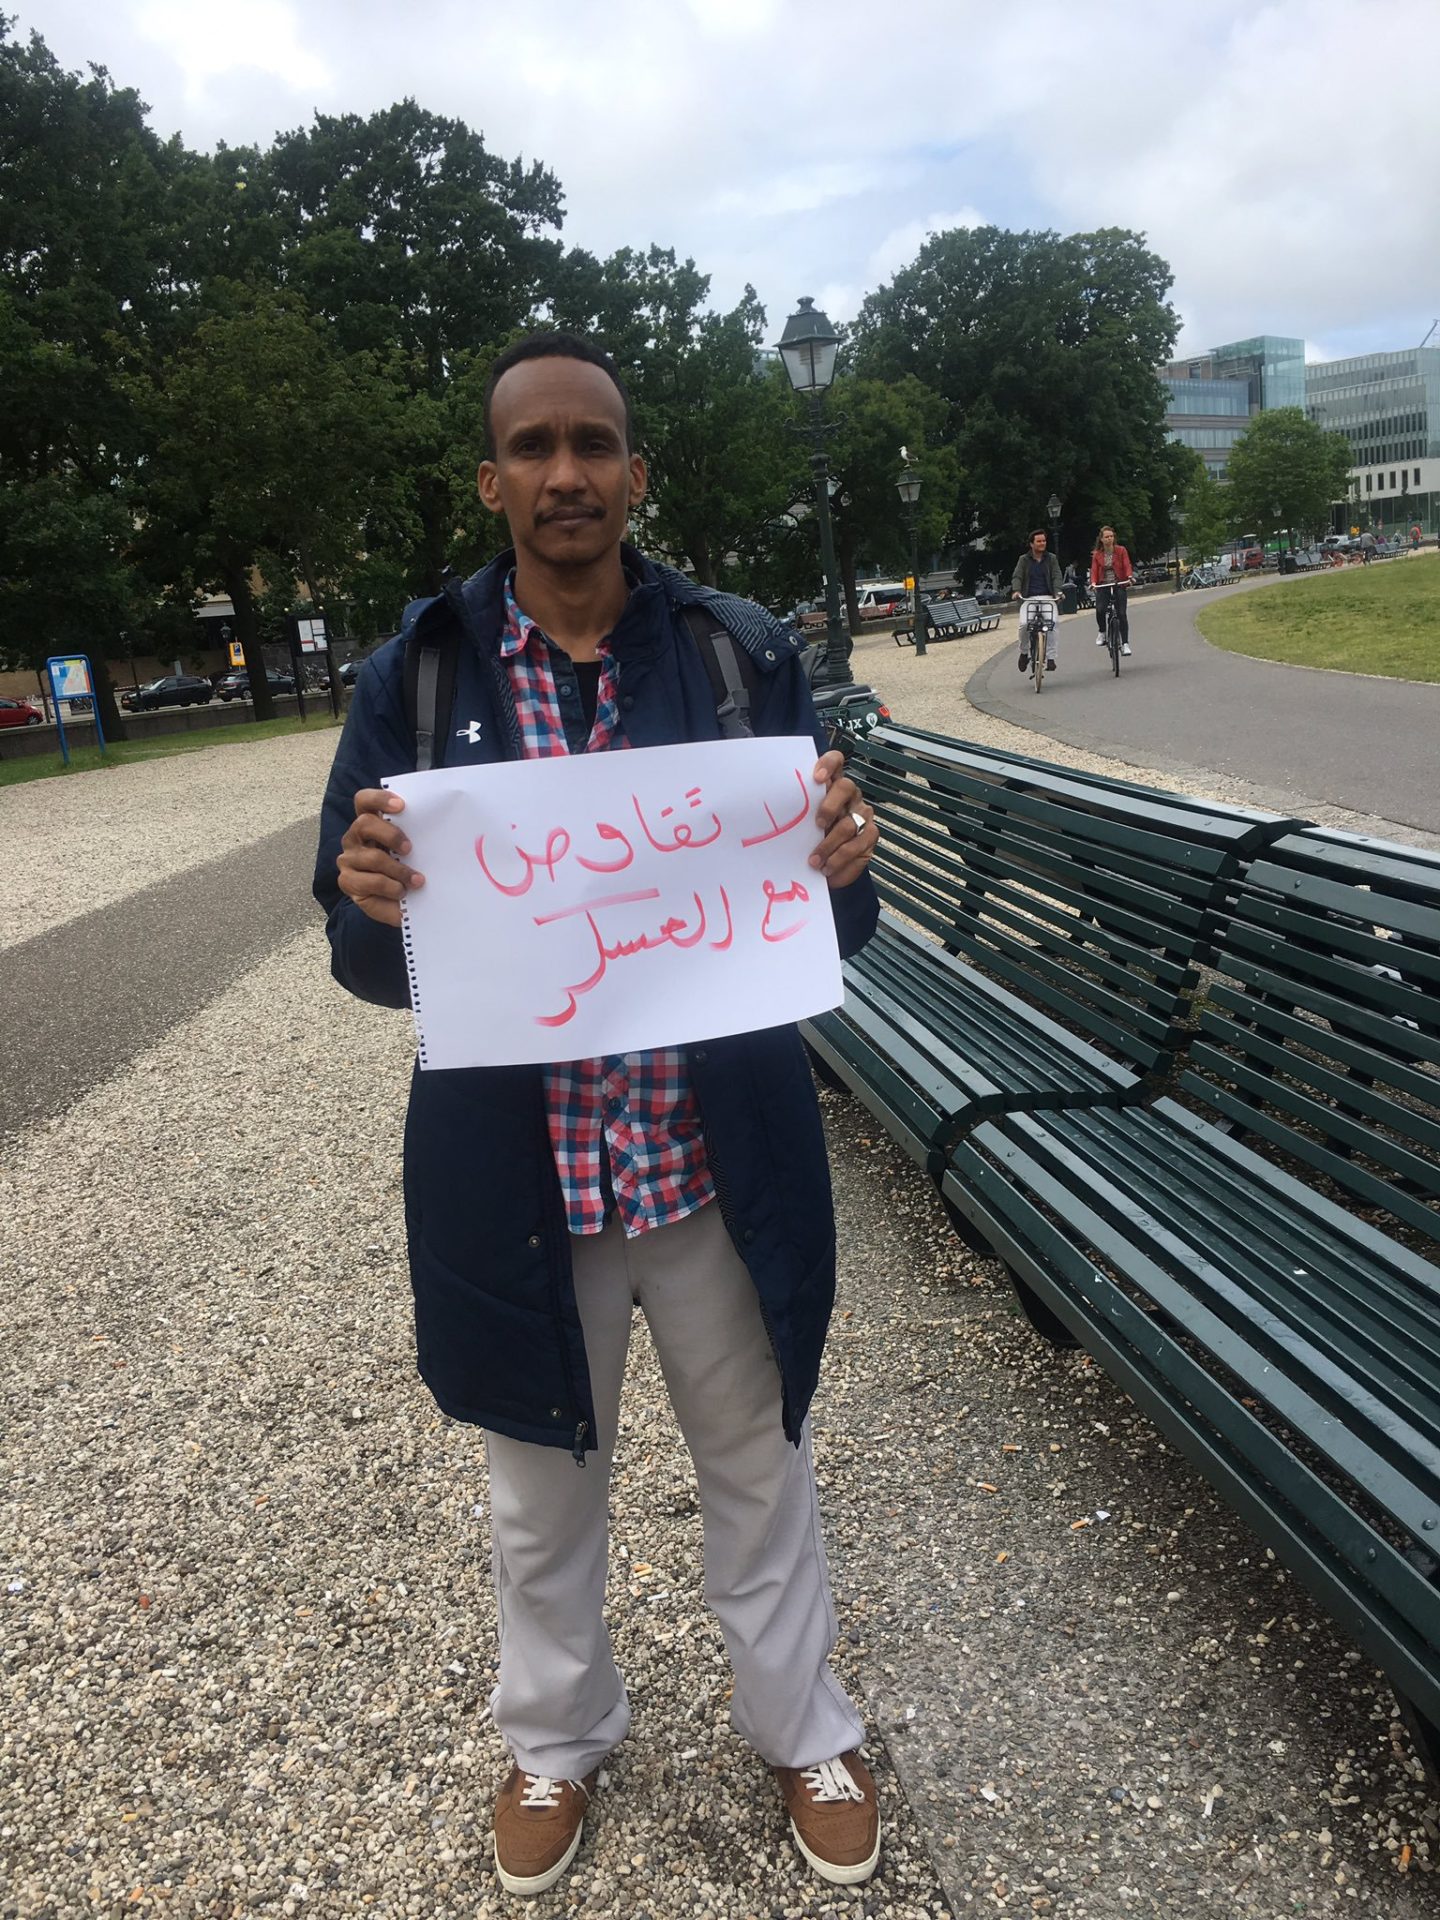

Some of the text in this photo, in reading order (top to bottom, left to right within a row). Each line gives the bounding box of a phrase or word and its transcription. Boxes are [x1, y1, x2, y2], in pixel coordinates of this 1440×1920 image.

[742, 768, 811, 848] لا
[533, 879, 810, 1028] مع العسكر
